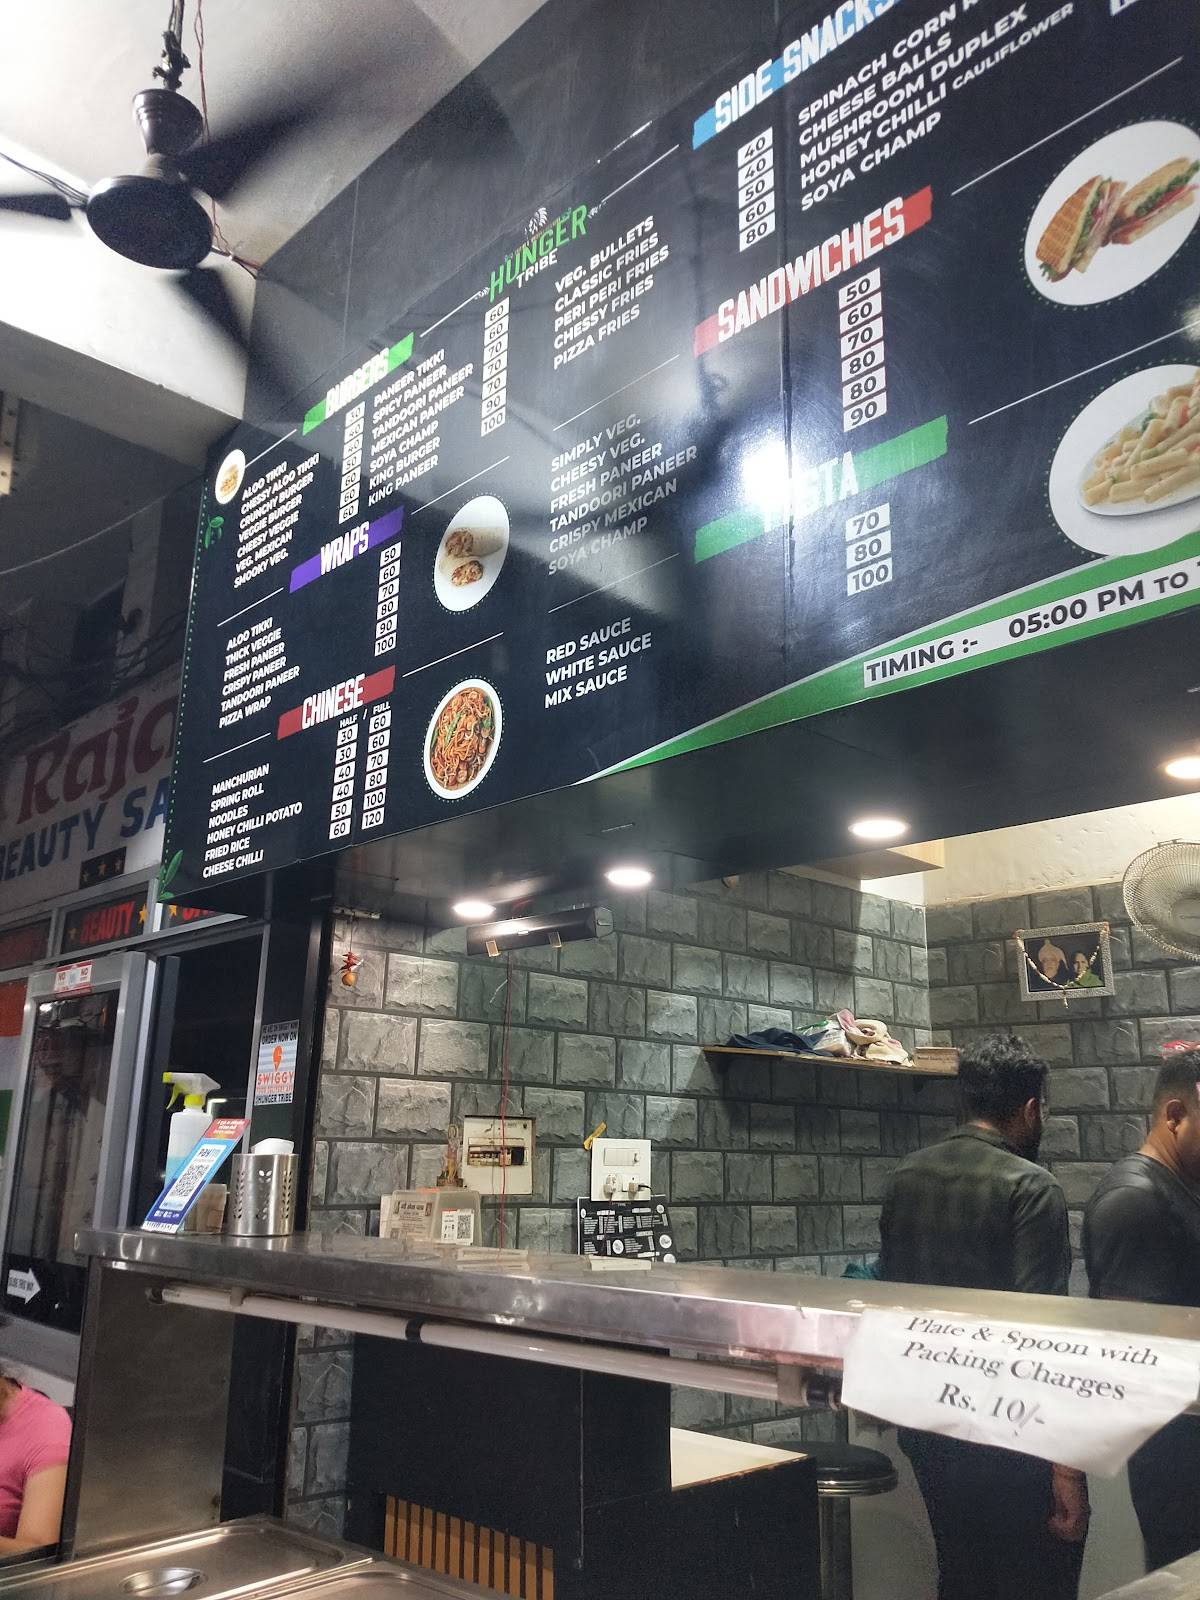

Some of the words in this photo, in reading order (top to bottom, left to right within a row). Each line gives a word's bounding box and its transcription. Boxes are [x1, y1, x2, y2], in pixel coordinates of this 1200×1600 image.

[799, 52, 887, 126] SPINACH
[893, 6, 957, 57] CORN
[801, 75, 924, 167] MUSHROOM
[930, 4, 1028, 82] DUPLEX
[714, 59, 773, 132] SIDE
[800, 82, 876, 145] CHEESE
[882, 32, 952, 94] BALLS
[801, 130, 870, 189] HONEY
[877, 81, 947, 138] CHILLI
[952, 3, 1073, 90] CAULIFLOWER
[743, 137, 767, 160] 40
[801, 172, 855, 211] SOYA
[860, 112, 941, 172] CHAMP
[744, 159, 767, 180] 40
[745, 180, 766, 202] 50
[745, 201, 767, 224] 60
[490, 205, 587, 303] HUNGER
[555, 266, 587, 293] VEG.
[589, 215, 654, 268] BULLETS
[745, 223, 768, 246] 80
[516, 248, 558, 288] TRIBE
[555, 264, 612, 312] CLASSIC
[616, 233, 659, 273] FRIES
[717, 196, 905, 343] SANDWICHES
[555, 301, 585, 332] PERI
[589, 277, 622, 310] PERI
[625, 245, 669, 285] FRIES
[846, 278, 870, 303] 50
[554, 303, 608, 350] CHESSY
[611, 274, 654, 314] FRIES
[847, 302, 873, 326] 60
[554, 336, 595, 370] PIZZA
[598, 304, 640, 342] FRIES
[848, 327, 873, 351] 70
[374, 371, 414, 407] PANEER
[417, 349, 444, 376] TIKKI
[849, 350, 875, 374] 80
[372, 395, 426, 439] TANDOORI
[429, 363, 473, 402] PANEER
[373, 395, 402, 424] SPICY
[404, 364, 447, 402] PANEER
[851, 376, 876, 400] 80
[371, 418, 417, 456] MEXICAN
[420, 386, 465, 423] PANEER
[851, 401, 877, 425] 90
[370, 448, 396, 472] SOYA
[399, 420, 439, 454] CHAMP
[551, 432, 602, 472] SIMPLY
[606, 413, 641, 440] VEG.
[551, 451, 606, 492] CHEESY
[610, 432, 645, 459] VEG.
[242, 478, 265, 501] ALOO
[266, 461, 287, 483] TIKKI
[272, 470, 296, 494] ALOO
[297, 453, 319, 475] TIKKI
[369, 465, 394, 490] KING
[396, 436, 440, 472] BURGER
[369, 482, 393, 506] KING
[395, 455, 438, 490] PANEER
[551, 478, 595, 513] FRESH
[601, 442, 662, 486] PANEER
[240, 496, 278, 529] CRUNCHY
[279, 472, 313, 503] BURGER
[550, 481, 626, 532] TANDOORI
[632, 445, 697, 491] PANEER
[237, 531, 268, 558] CHEESY
[269, 510, 299, 537] VEGGIE
[239, 517, 267, 542] VEGGIE
[268, 494, 302, 524] BURGER
[550, 517, 600, 553] CRISPY
[605, 478, 677, 527] MEXICAN
[852, 512, 880, 536] 70
[236, 556, 253, 573] VEG.
[255, 530, 292, 561] MEXICAN
[269, 548, 289, 566] VEG.
[321, 522, 369, 575] WRAPS
[384, 547, 395, 561] 50
[549, 547, 587, 575] SOYA
[590, 516, 648, 555] CHAMP
[854, 538, 882, 561] 80
[382, 584, 393, 598] 70
[383, 566, 395, 580] 60
[852, 565, 889, 591] 100
[380, 620, 392, 633] 90
[381, 602, 393, 615] 80
[866, 641, 954, 682] TIMING
[1009, 599, 1087, 639] 05:00
[1098, 580, 1144, 612] PM
[1154, 571, 1189, 594] TO
[225, 645, 249, 666] THICK
[251, 628, 281, 652] VEGGIE
[227, 631, 249, 650] ALOO
[250, 617, 273, 637] TIKKI
[378, 637, 393, 651] 100
[546, 641, 576, 664] RED
[579, 617, 631, 650] SAUCE
[222, 674, 251, 696] CRISPY
[253, 656, 286, 682] PANEER
[224, 662, 249, 681] FRESH
[251, 642, 284, 668] PANEER
[545, 655, 595, 686] WHITE
[598, 632, 652, 666] SAUCE
[221, 686, 263, 712] TANDOORI
[265, 666, 300, 691] PANEER
[302, 673, 365, 729] CHINESE
[545, 686, 572, 708] MIX
[575, 665, 628, 697] SAUCE
[219, 709, 243, 728] PIZZA
[245, 696, 271, 716] WRAP
[339, 715, 358, 728] HALF
[373, 701, 390, 715] FULL
[374, 716, 386, 728] 60
[339, 747, 351, 759] 30
[341, 729, 352, 741] 30
[373, 735, 384, 747] 60
[212, 764, 269, 795] MANCHURIAN
[338, 766, 350, 779] 40
[370, 773, 382, 786] 80
[372, 754, 383, 766] 70
[210, 791, 240, 812] SPRING
[242, 783, 264, 803] ROLL
[335, 803, 347, 815] 50
[337, 785, 349, 797] 40
[367, 792, 383, 804] 100
[207, 826, 236, 845] HONEY
[237, 814, 263, 833] CHILLI
[265, 802, 302, 824] POTATO
[209, 805, 248, 828] NOODLES
[334, 823, 345, 835] 60
[365, 812, 380, 825] 120
[203, 857, 234, 878] CHEESE
[236, 850, 263, 868] CHILLI
[205, 844, 229, 861] FRIED
[230, 837, 250, 854] RICE
[258, 1072, 293, 1085] SWIGGY
[905, 1317, 965, 1339] Plate
[972, 1327, 991, 1341] &
[1002, 1330, 1088, 1356] Spoon
[1100, 1346, 1159, 1367] with
[902, 1341, 1001, 1377] Packing
[1011, 1360, 1126, 1401] Charges
[937, 1383, 976, 1412] Rs.
